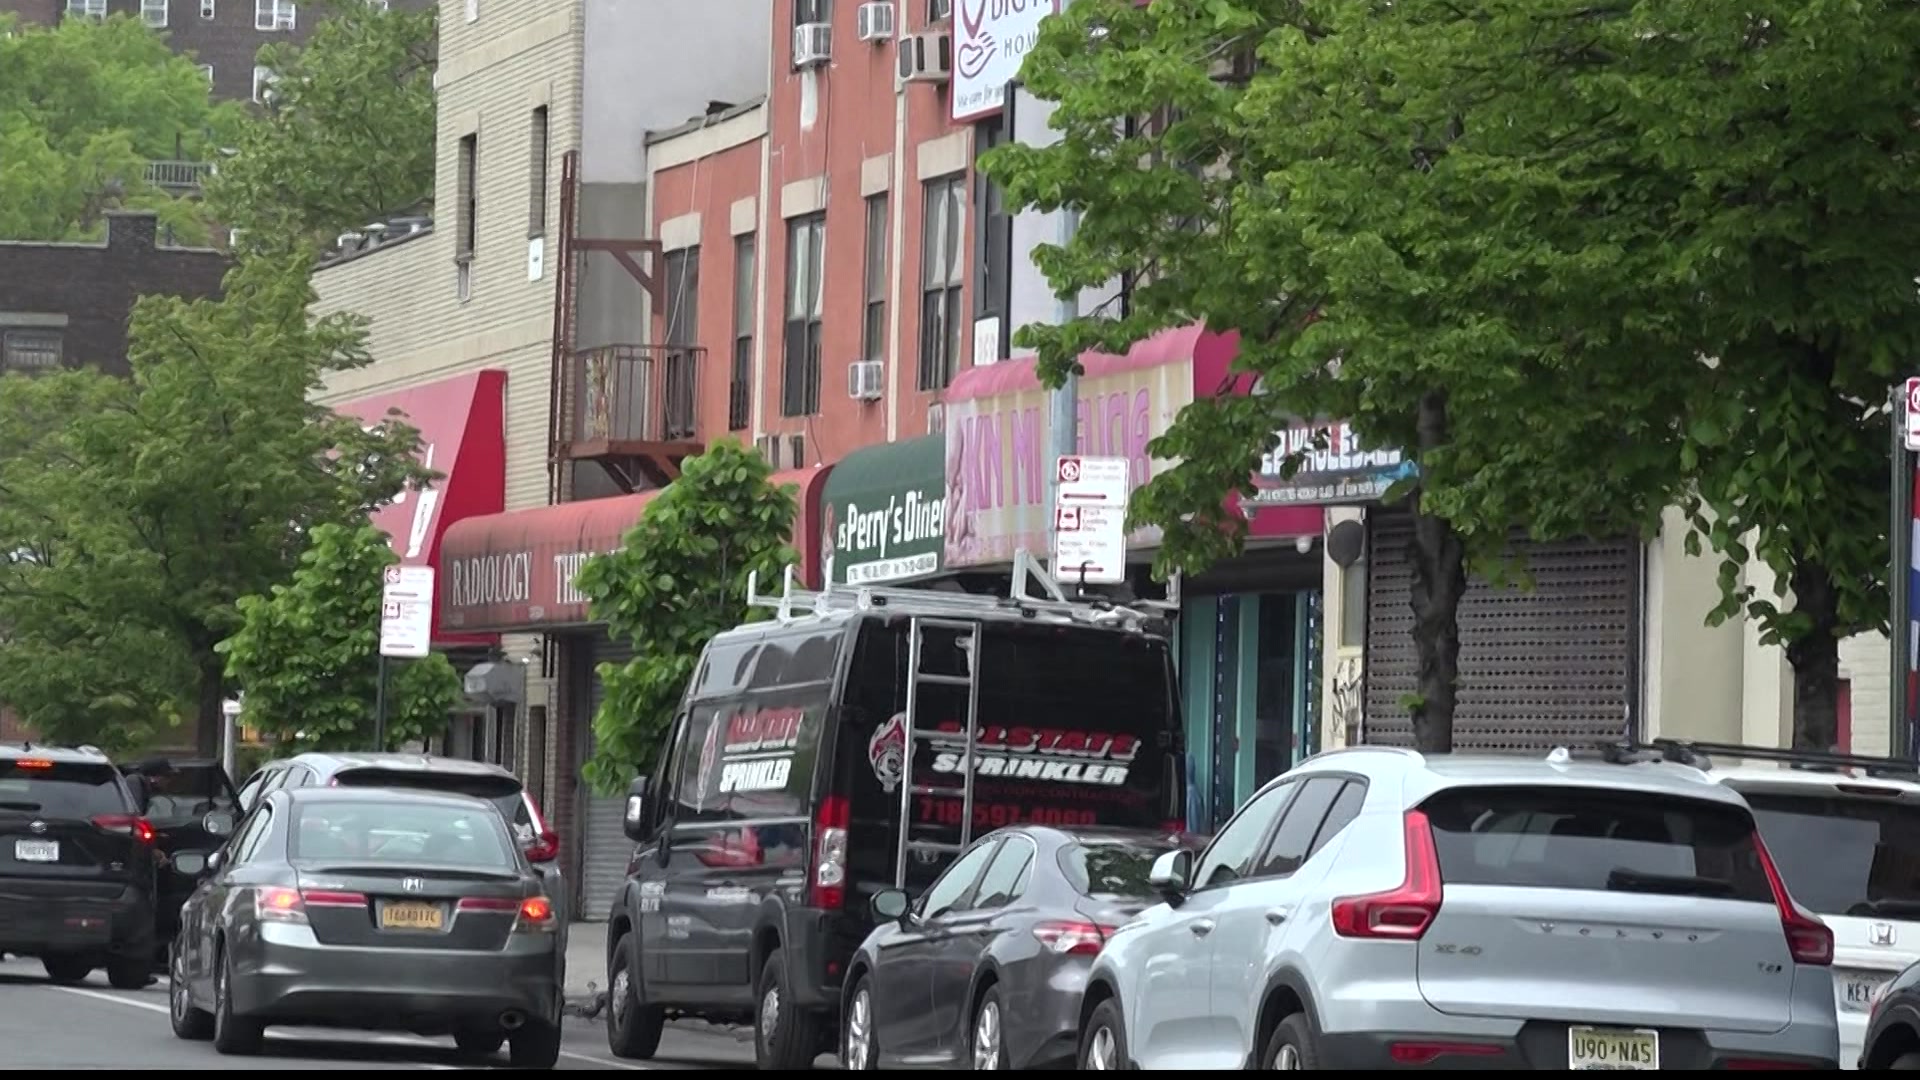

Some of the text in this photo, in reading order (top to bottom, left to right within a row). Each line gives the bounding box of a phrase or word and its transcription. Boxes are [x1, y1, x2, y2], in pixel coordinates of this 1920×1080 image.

[903, 490, 945, 542] Diner
[452, 552, 532, 606] RADIOLOGY
[719, 758, 792, 793] SPRINKLER
[931, 753, 1129, 786] SPRINKLER
[1540, 921, 1699, 944] VOLVO
